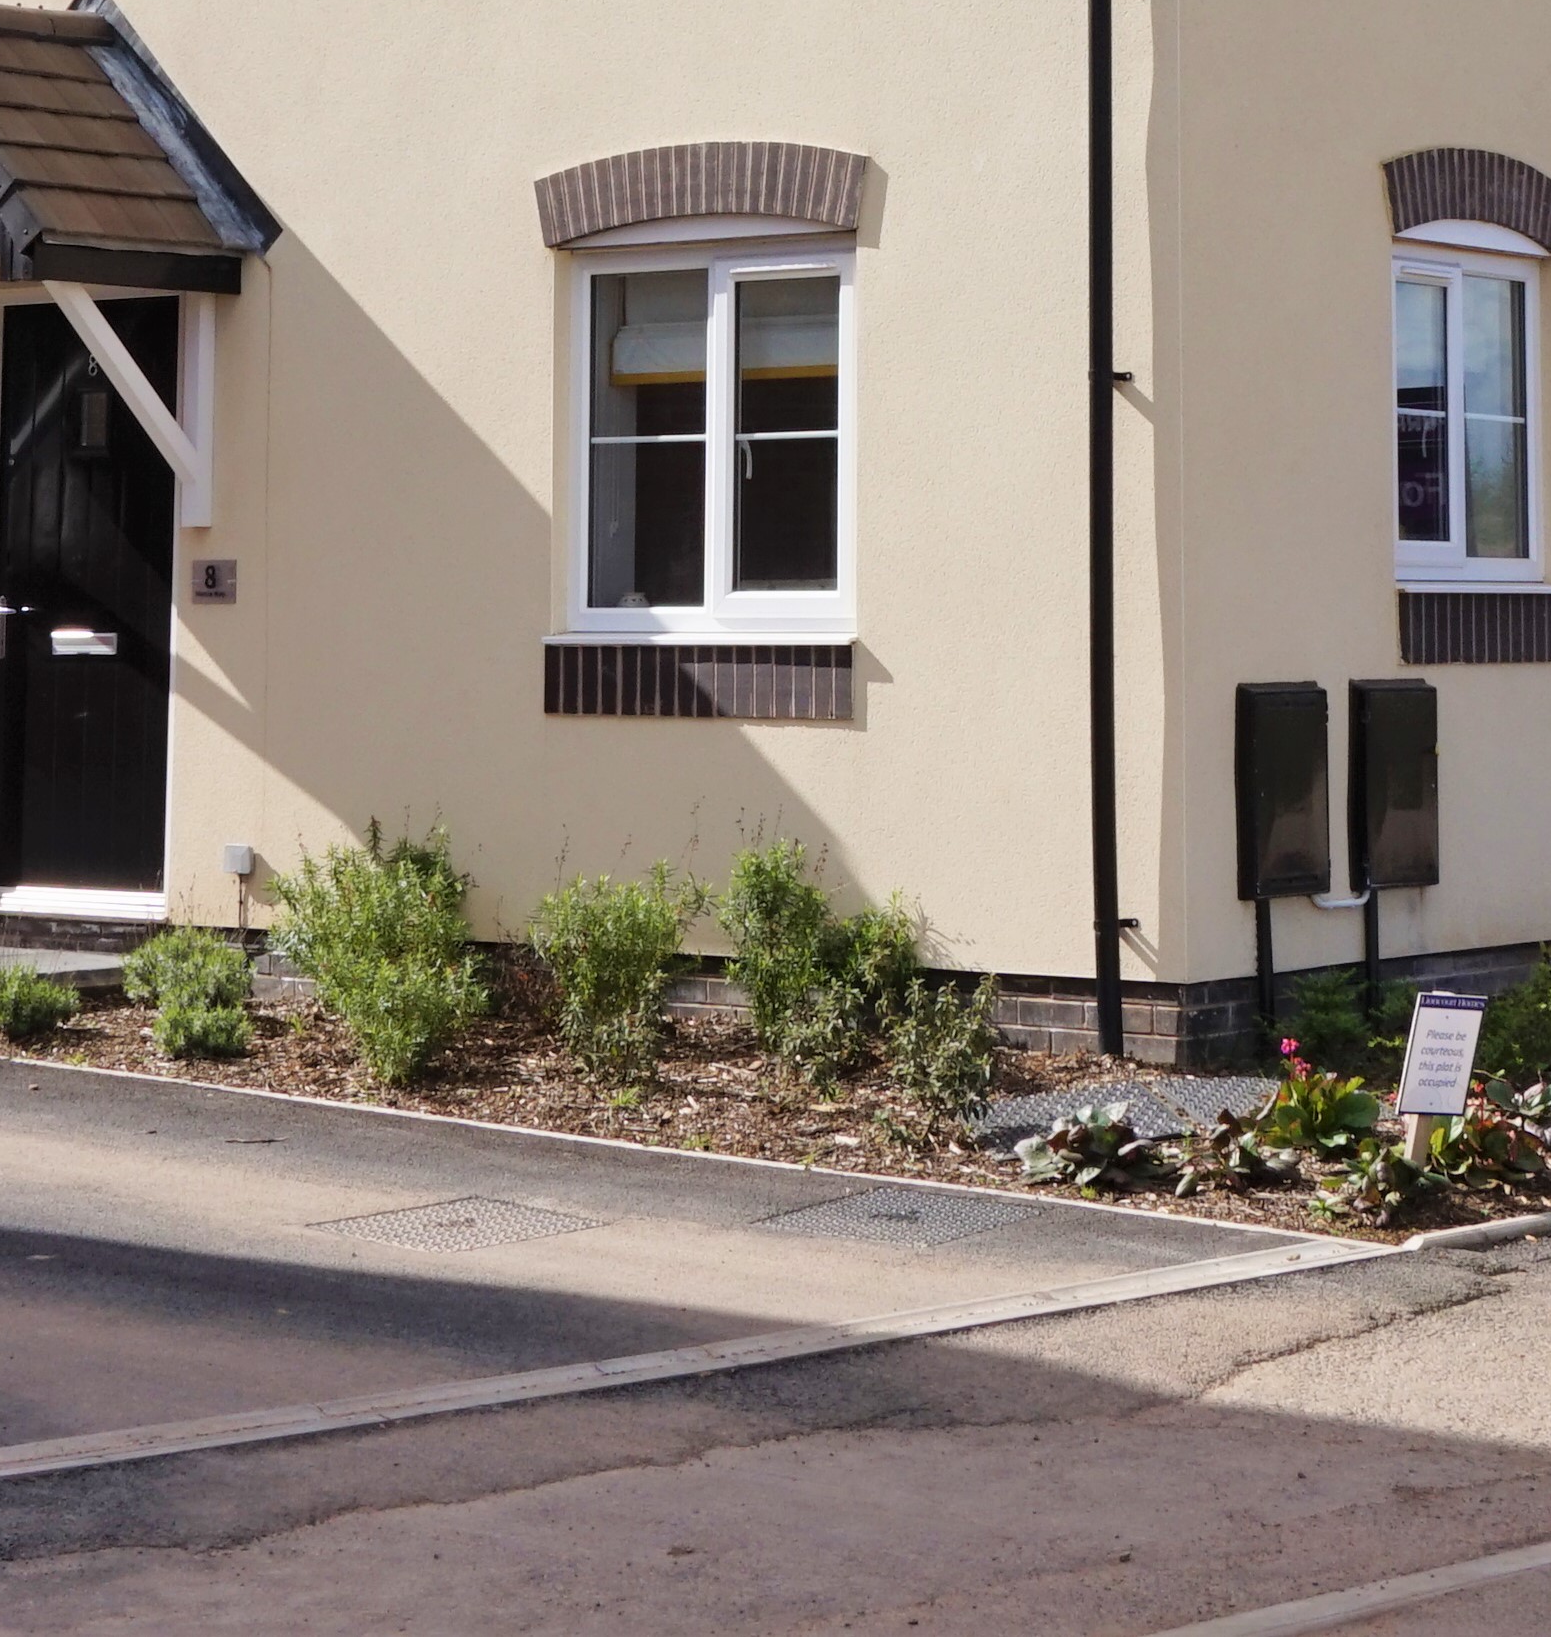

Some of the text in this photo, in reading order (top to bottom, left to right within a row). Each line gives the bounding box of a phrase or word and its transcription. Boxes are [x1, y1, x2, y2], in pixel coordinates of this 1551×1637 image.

[89, 354, 98, 376] 8
[205, 565, 216, 589] 8
[1426, 1029, 1467, 1041] Please be
[1418, 1060, 1462, 1073] this plot is
[1418, 1076, 1457, 1088] occupied
